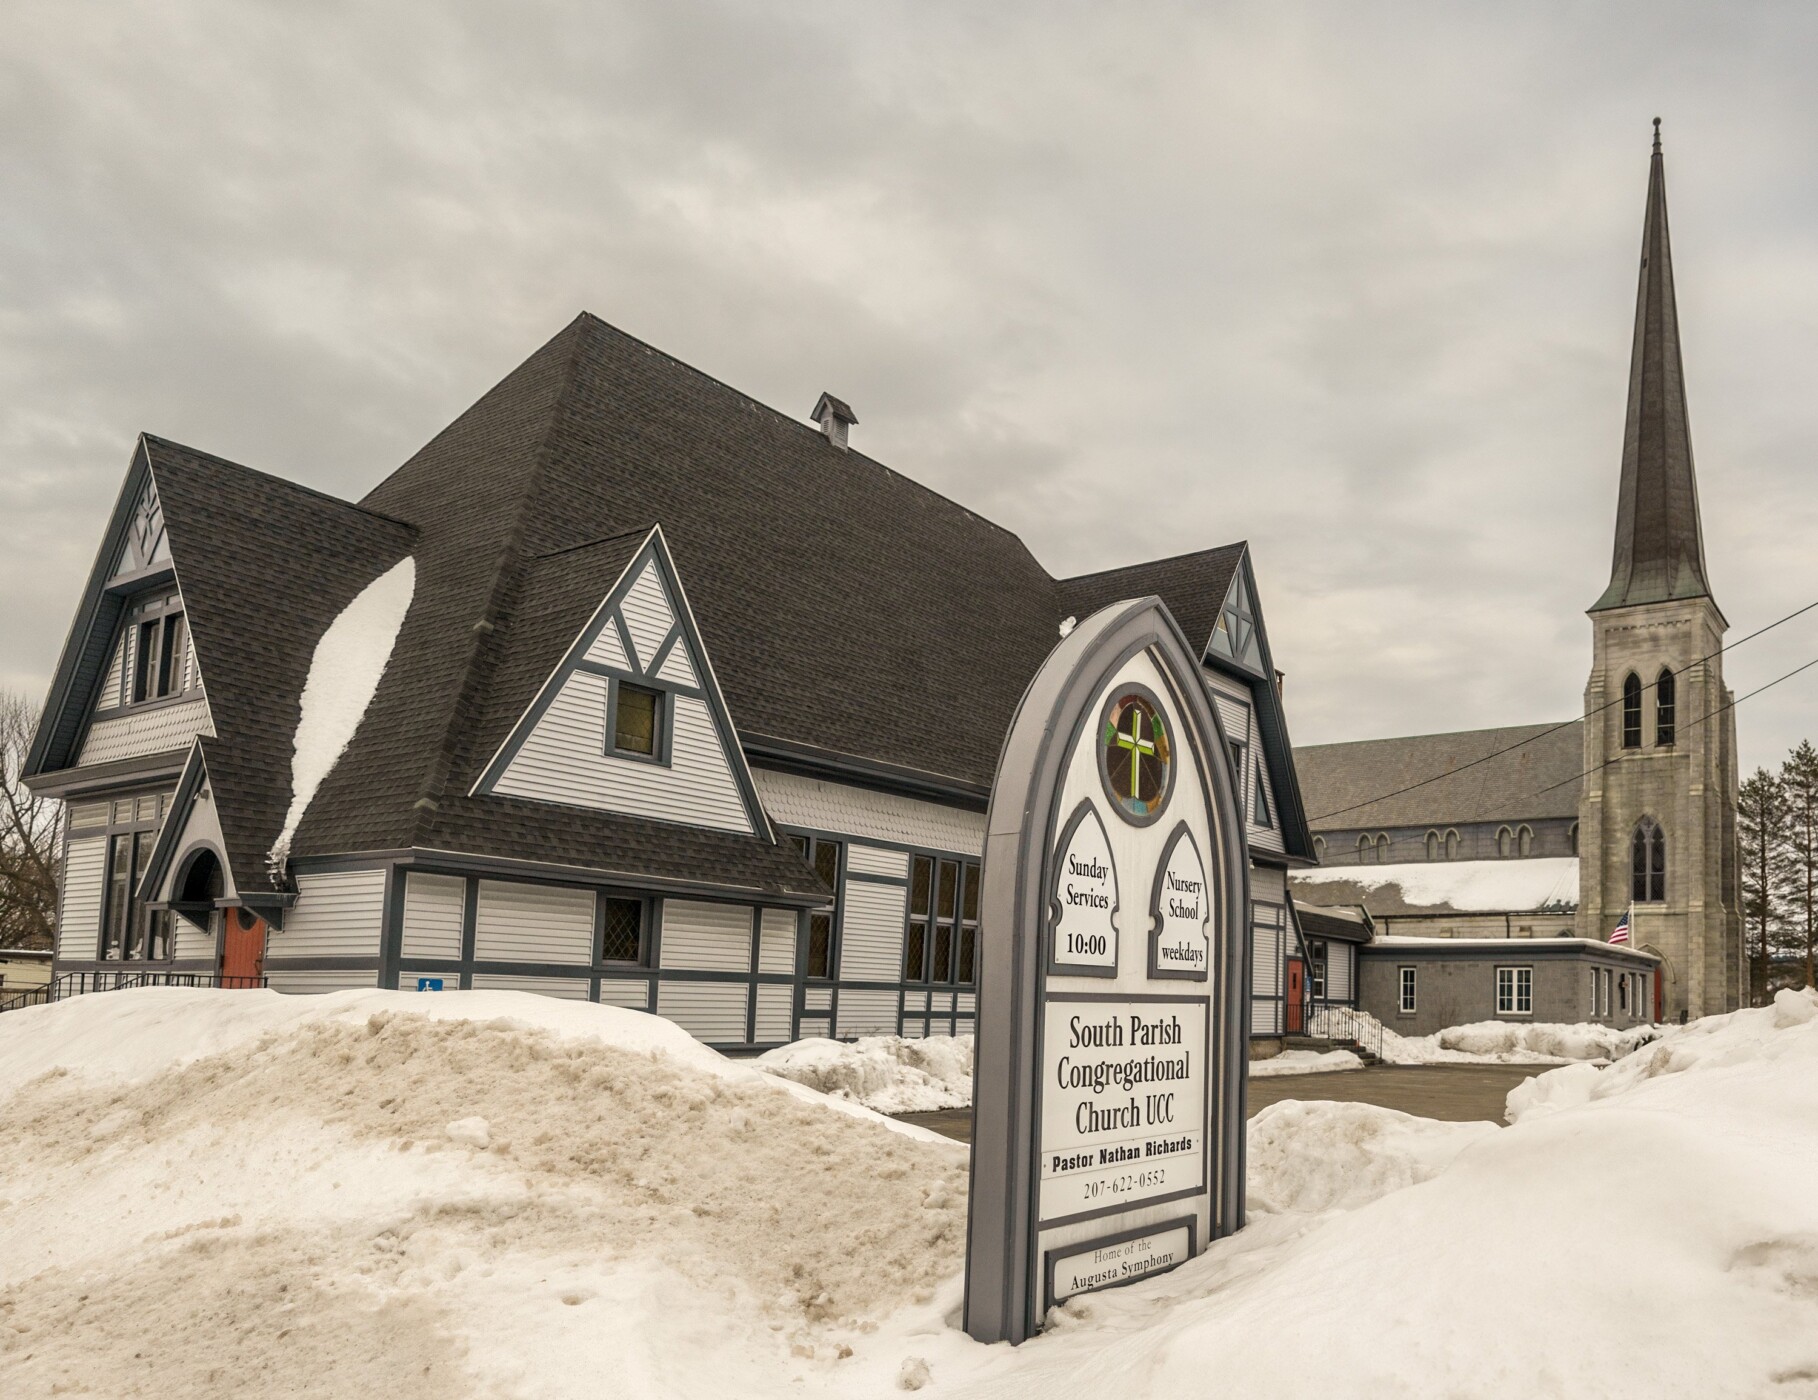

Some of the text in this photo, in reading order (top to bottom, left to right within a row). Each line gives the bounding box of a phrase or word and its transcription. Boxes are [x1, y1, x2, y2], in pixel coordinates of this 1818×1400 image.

[1068, 853, 1109, 887] Sunday
[1166, 870, 1202, 900] Nursery
[1066, 883, 1109, 909] Services
[1168, 897, 1199, 920] School
[1067, 933, 1107, 956] 10:00
[1162, 941, 1203, 968] weekdays
[1070, 1015, 1182, 1049] South Parish
[1057, 1051, 1190, 1094] Congregational
[1075, 1092, 1174, 1135] Church UCC
[1052, 1136, 1192, 1173] Pastor Nathan Richards
[1083, 1169, 1165, 1200] 207-622-0552
[1094, 1238, 1152, 1264] Home of the
[1070, 1252, 1174, 1291] Augusta Symphony
